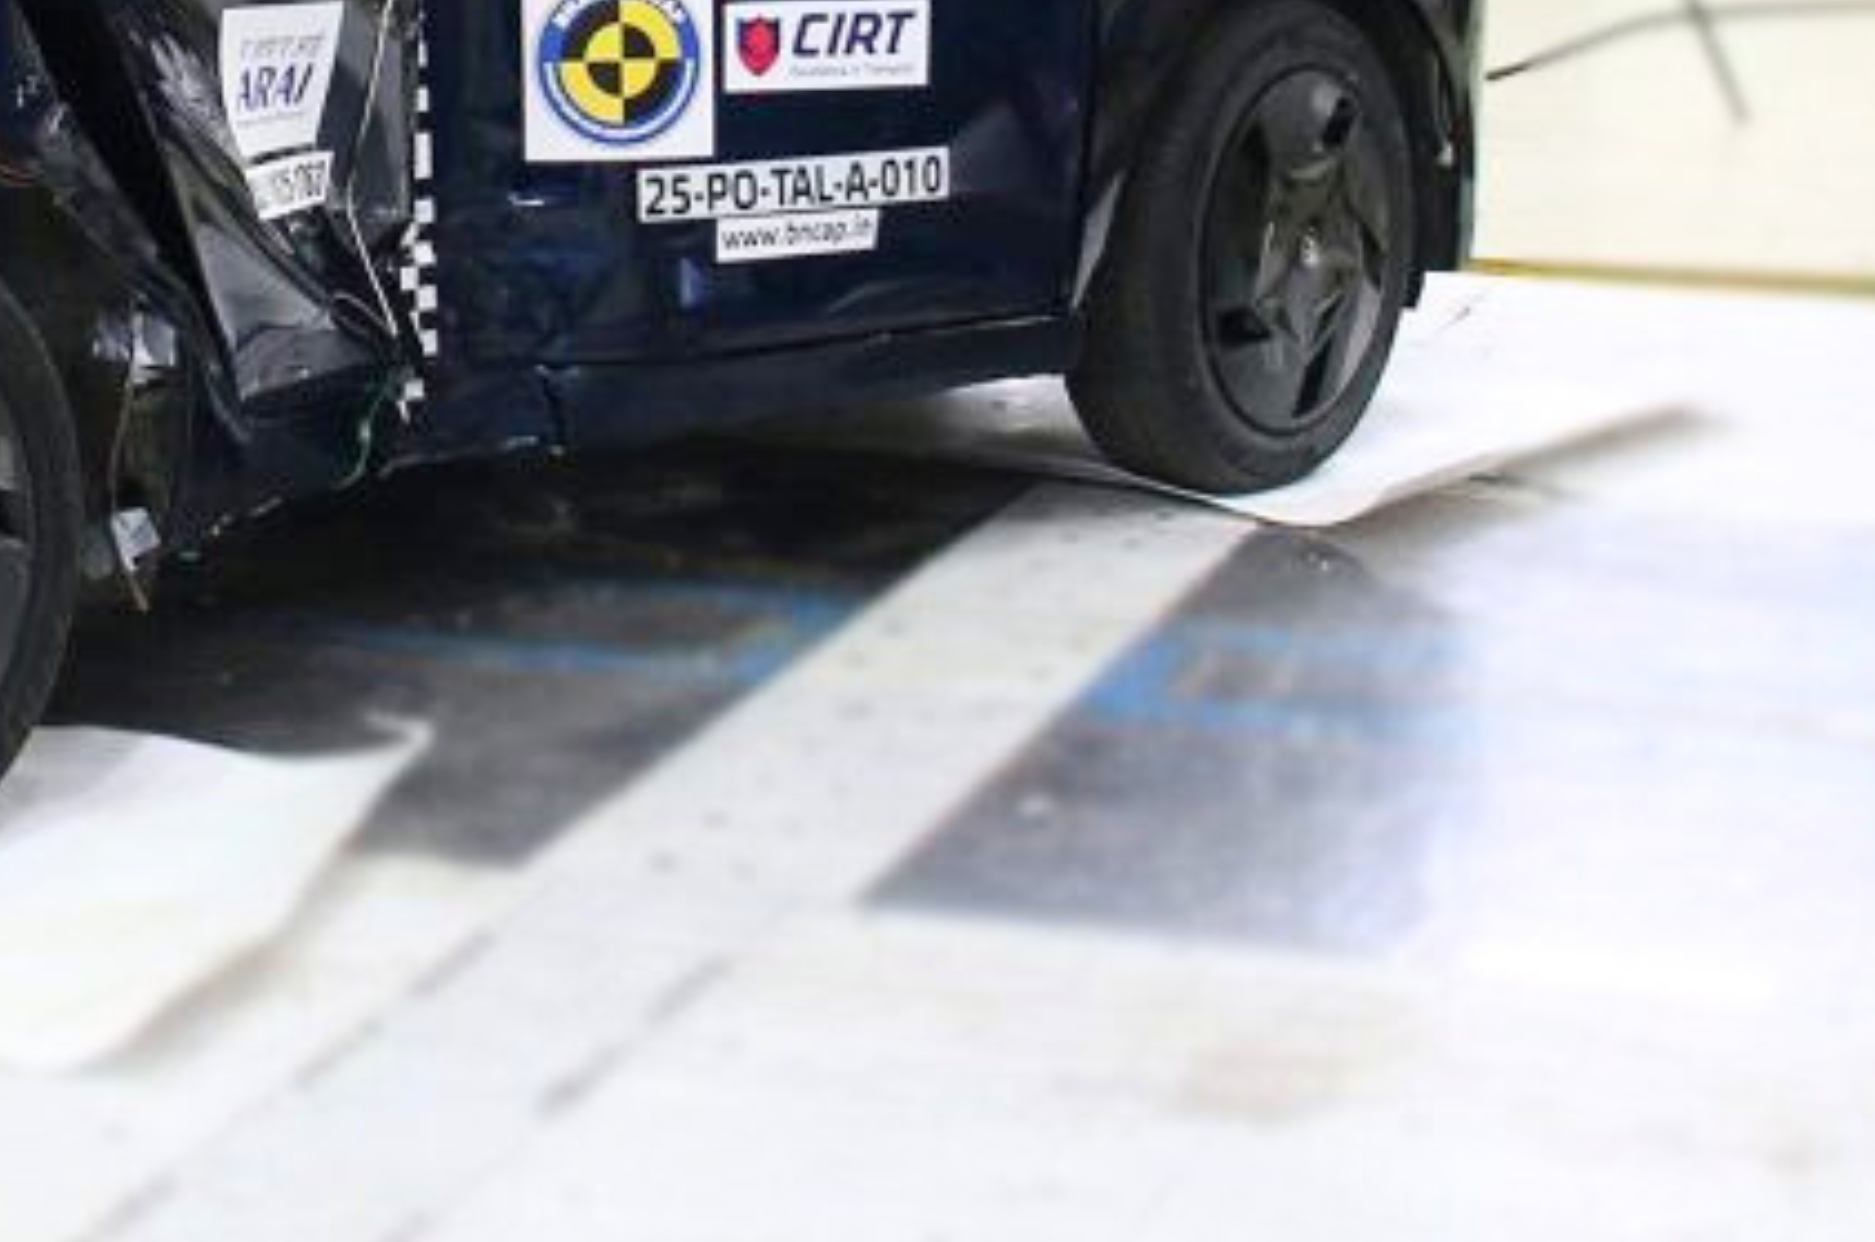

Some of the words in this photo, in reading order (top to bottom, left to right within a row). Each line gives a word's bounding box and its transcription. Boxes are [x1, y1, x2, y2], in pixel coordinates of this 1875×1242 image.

[793, 11, 915, 57] CIRT
[238, 62, 314, 111] ARAI
[644, 156, 941, 215] 25-PO-TAL-A-010
[724, 212, 871, 249] www.bncap.in
